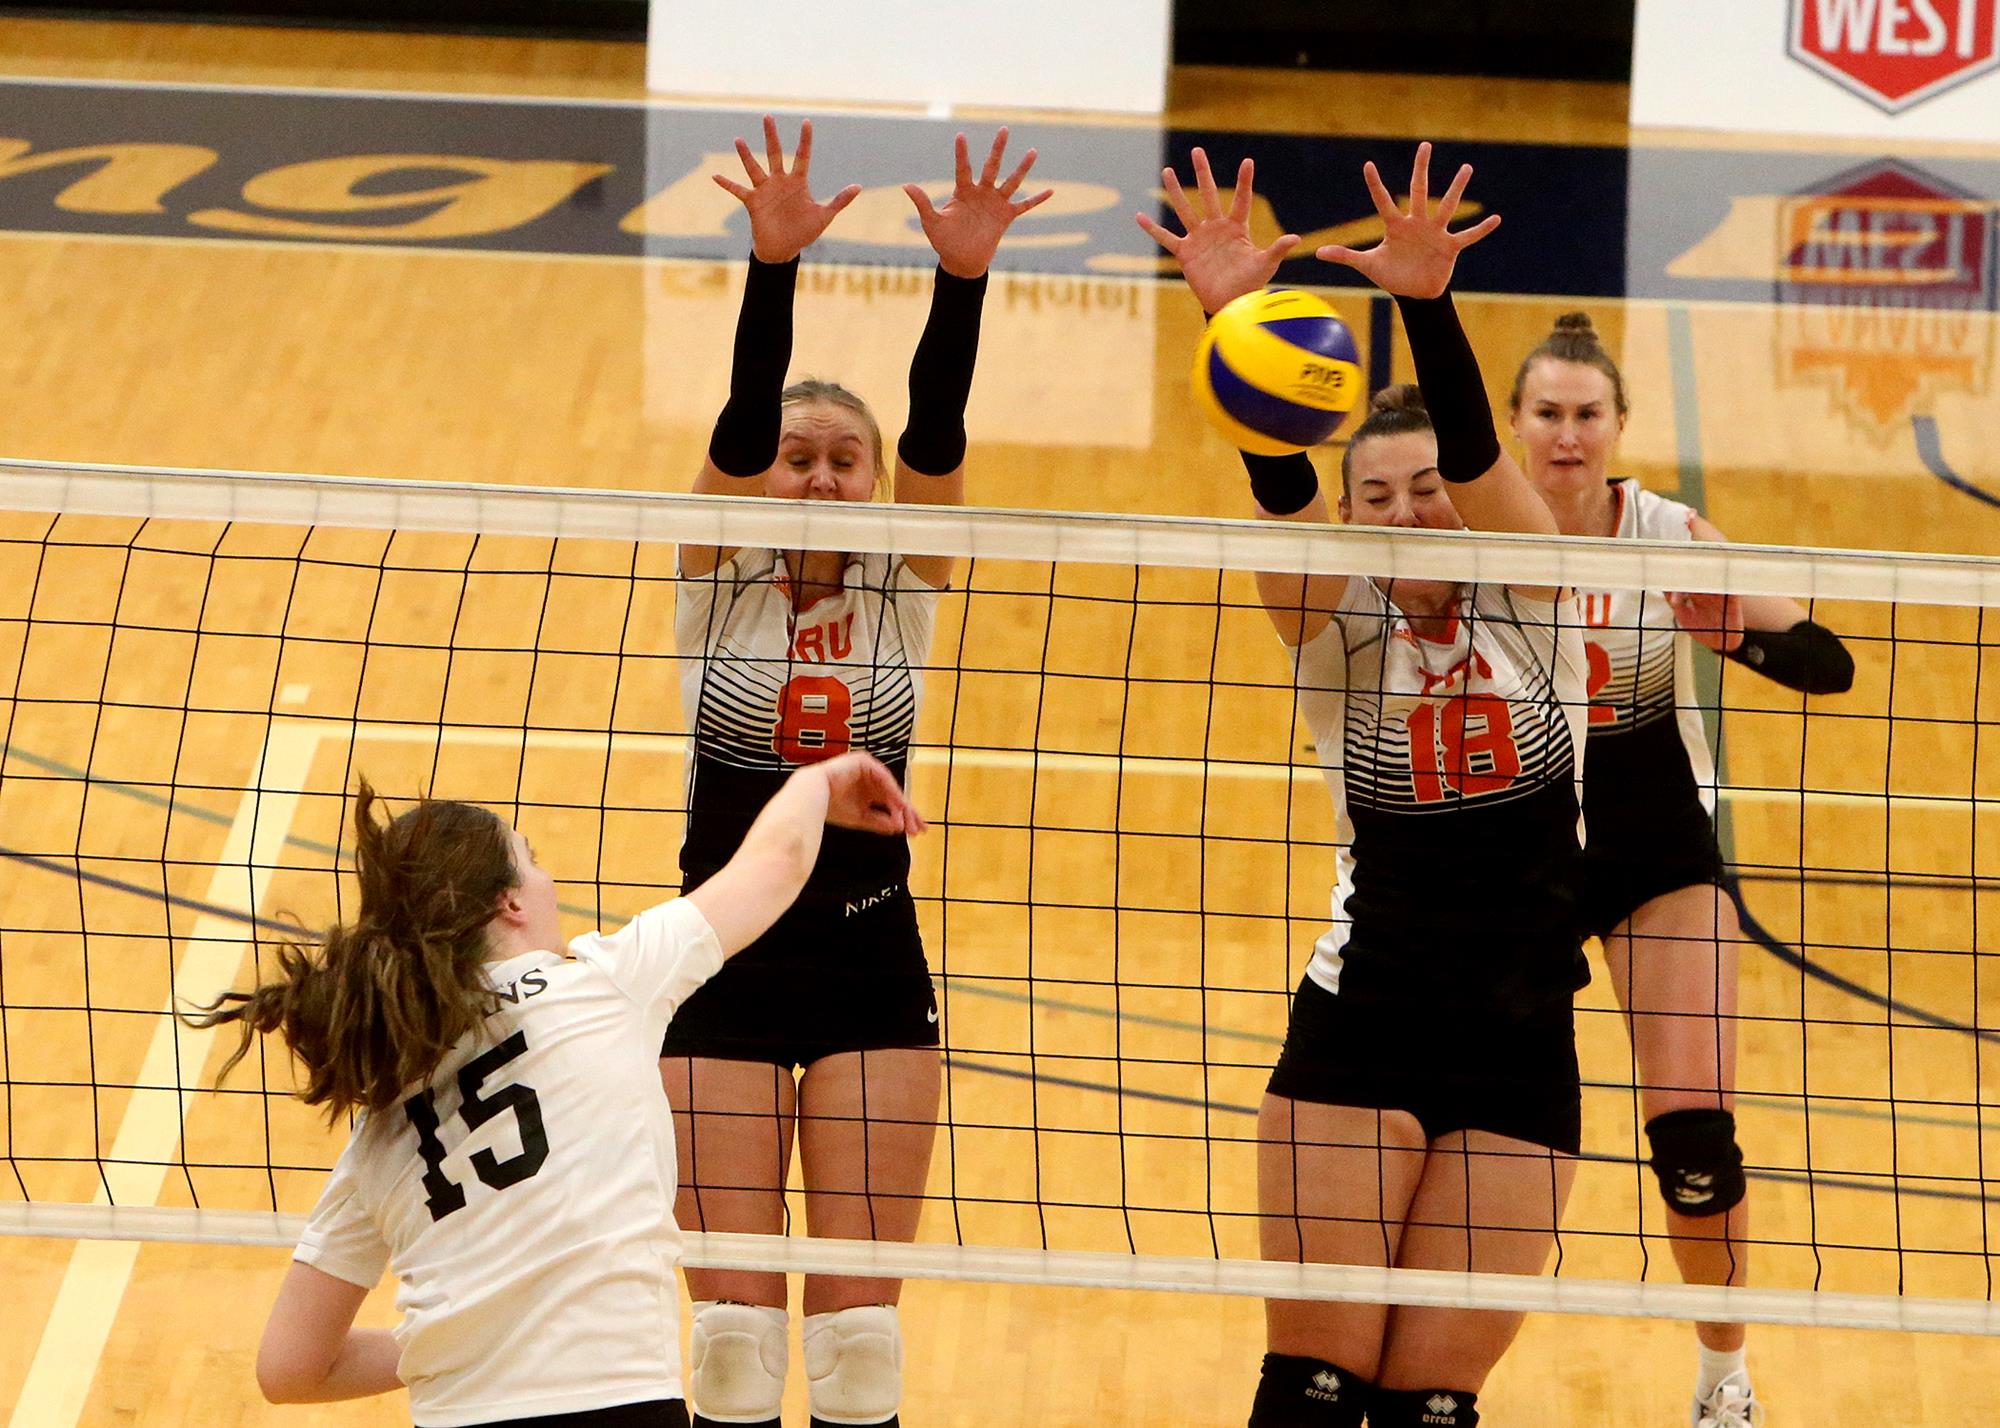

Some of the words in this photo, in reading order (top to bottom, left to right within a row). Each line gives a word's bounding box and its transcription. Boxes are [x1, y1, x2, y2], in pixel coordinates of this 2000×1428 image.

[1816, 0, 1976, 58] WEST
[786, 612, 854, 664] RU
[771, 675, 853, 764] 8
[1406, 693, 1522, 802] 18
[482, 968, 548, 1018] NS
[403, 1029, 550, 1222] 15
